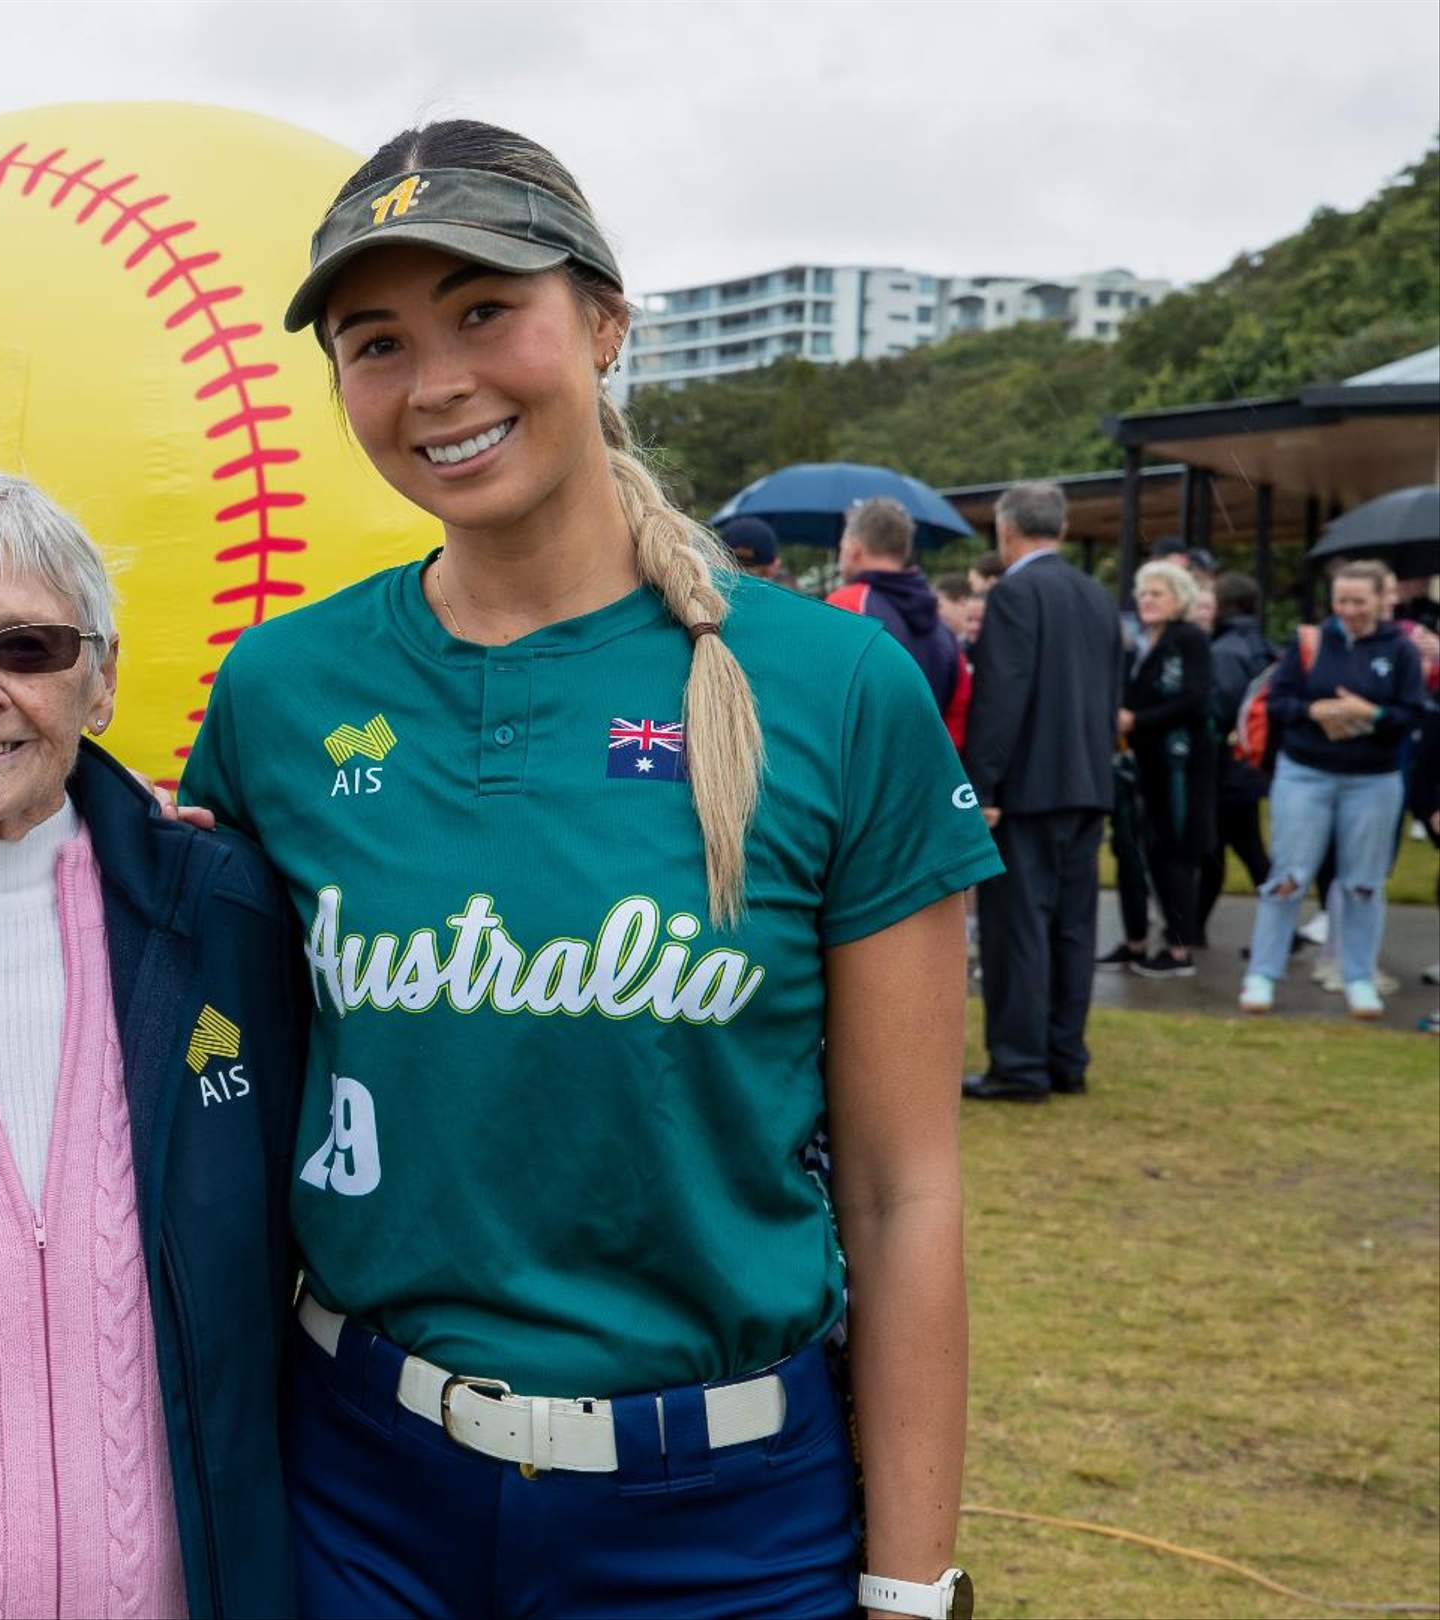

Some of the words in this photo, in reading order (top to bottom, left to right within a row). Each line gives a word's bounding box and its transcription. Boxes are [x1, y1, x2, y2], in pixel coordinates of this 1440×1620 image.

[331, 767, 383, 797] AIS
[304, 885, 765, 1025] Australia
[200, 1064, 250, 1107] AIS
